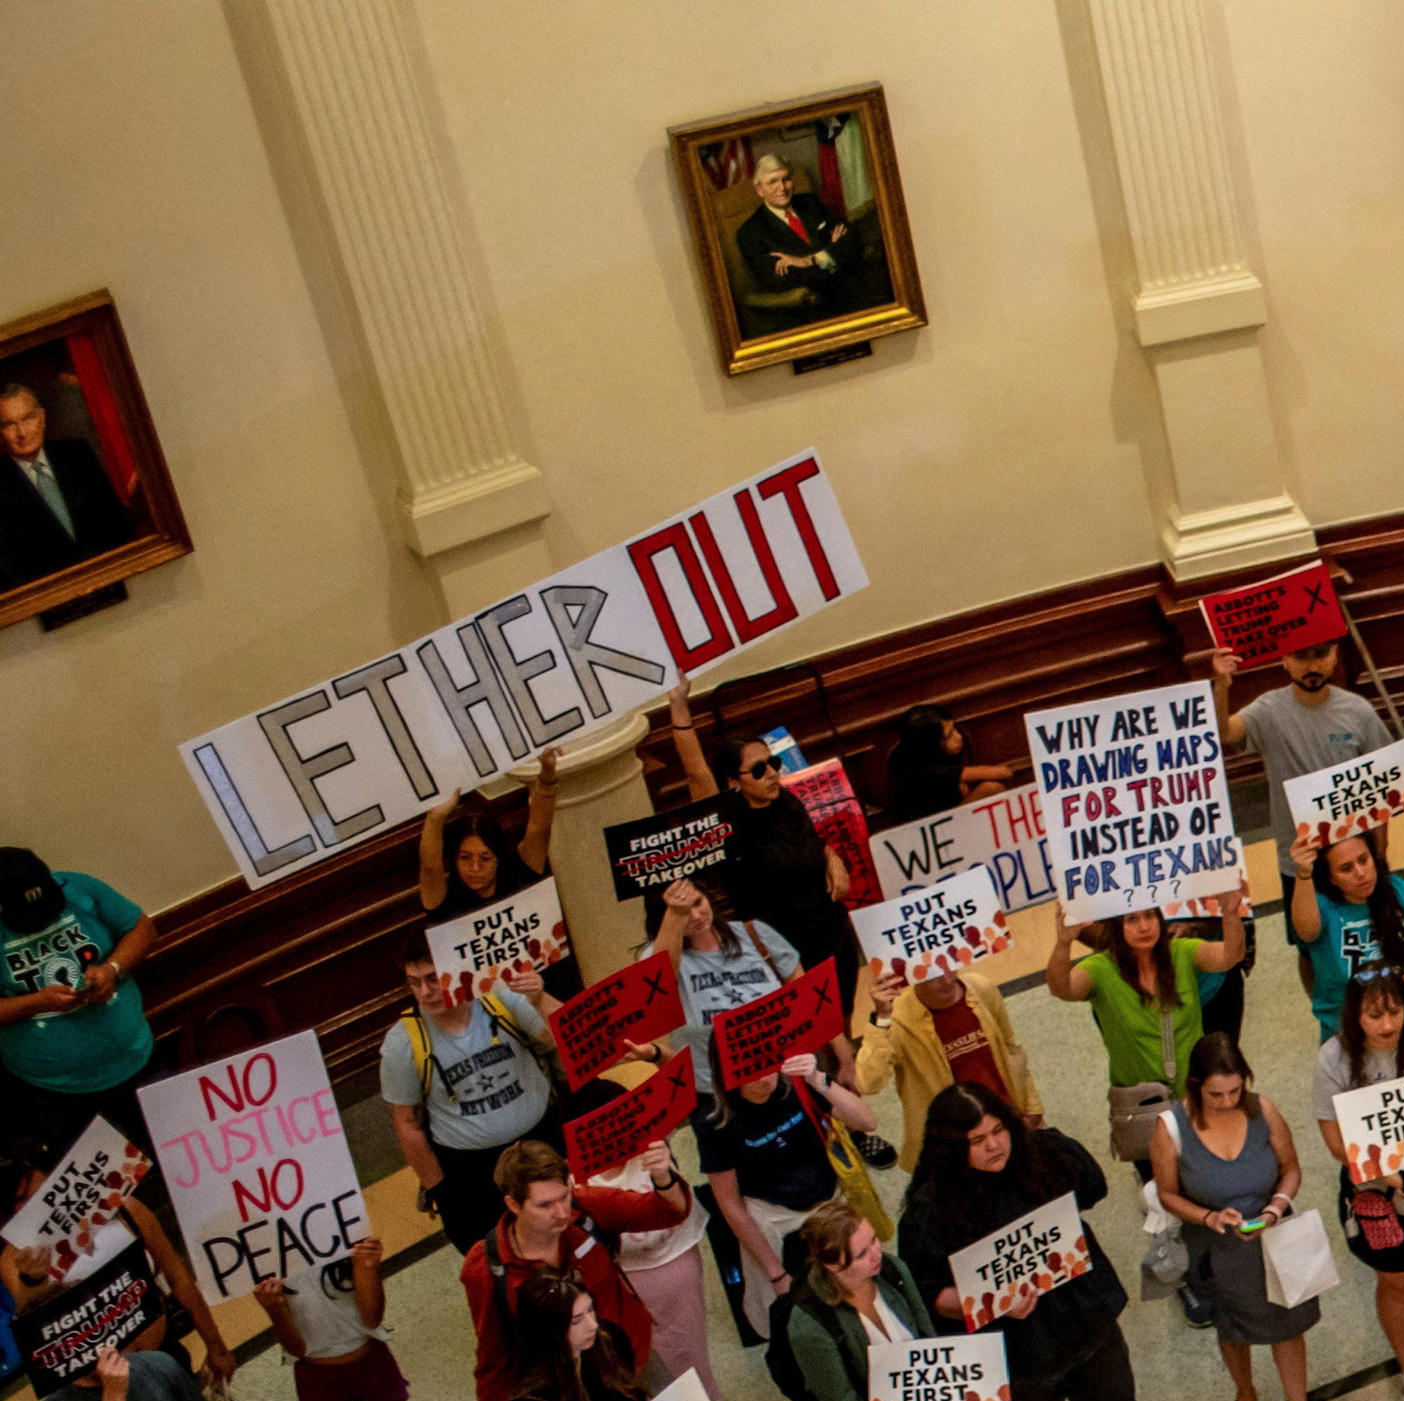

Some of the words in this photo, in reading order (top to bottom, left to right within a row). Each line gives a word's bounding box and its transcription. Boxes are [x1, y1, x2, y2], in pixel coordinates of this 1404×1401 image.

[626, 457, 840, 674] OUT
[1036, 715, 1099, 755] WHY
[1111, 706, 1159, 744] ARE
[1171, 696, 1207, 730] WE
[1042, 740, 1149, 790] DRAWING
[1158, 732, 1219, 766] MAPS
[1332, 761, 1374, 788] PUT
[1061, 788, 1122, 828] FOR
[1128, 767, 1217, 814] TRUMP
[1312, 766, 1401, 812] TEXANS
[1331, 787, 1390, 820] FIRST
[619, 823, 732, 877] TRUMP
[630, 828, 684, 852] FIGHT
[686, 814, 720, 836] THE
[883, 816, 963, 880] WE
[1070, 816, 1178, 859] INSTEAD
[1189, 803, 1221, 834] OF
[635, 850, 726, 887] TAKEOVER
[1064, 862, 1119, 901] FOR
[1126, 835, 1238, 886] TEXANS
[473, 907, 513, 934] PUT
[882, 899, 977, 945] TEXANS
[900, 892, 945, 921] PUT
[6, 926, 88, 973] BLACK
[455, 914, 540, 960] TEXANS
[473, 936, 532, 971] FIRST
[903, 922, 967, 957] FIRST
[197, 1052, 277, 1121] NO
[160, 1088, 342, 1190] JUSTICE
[38, 1151, 110, 1239] TEXANS
[42, 1160, 78, 1209] PUT
[61, 1174, 108, 1236] FIRST
[232, 1157, 304, 1223] NO
[203, 1189, 360, 1298] PEACE
[976, 1227, 1061, 1283] TEXANS
[994, 1222, 1034, 1255] PUT
[994, 1249, 1050, 1291] FIRST
[31, 1279, 147, 1370] TRUMP
[42, 1299, 98, 1340] FIGHT
[98, 1271, 134, 1308] THE
[889, 1363, 983, 1389] TEXANS
[909, 1347, 954, 1368] PUT
